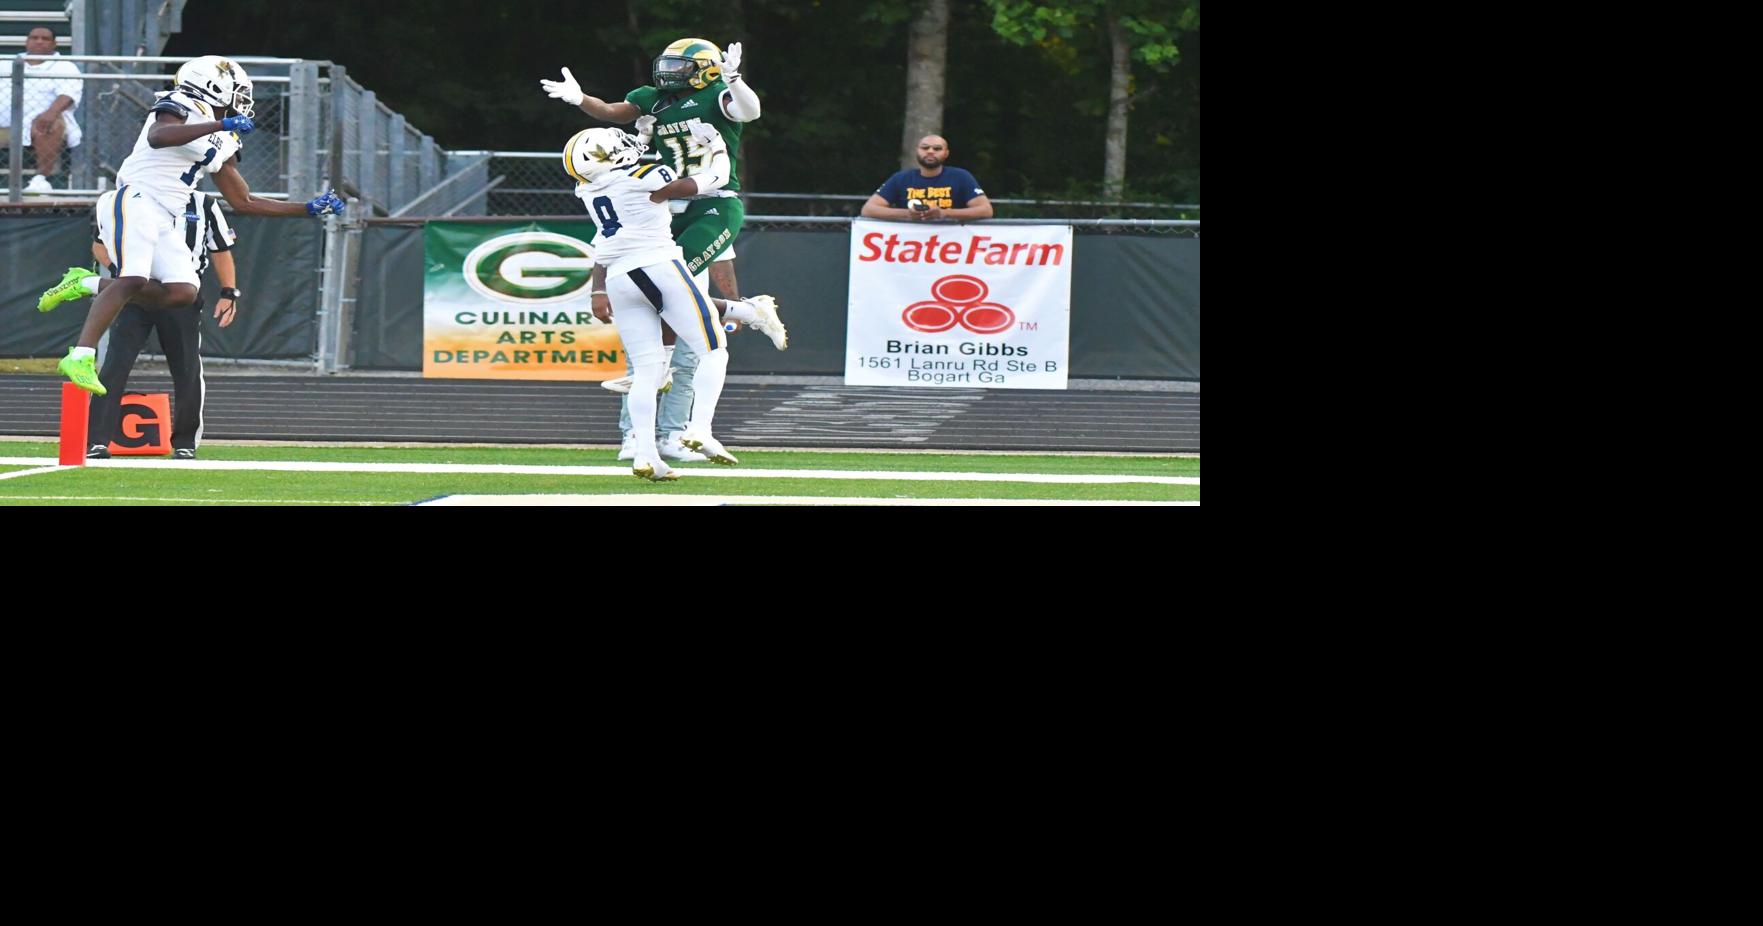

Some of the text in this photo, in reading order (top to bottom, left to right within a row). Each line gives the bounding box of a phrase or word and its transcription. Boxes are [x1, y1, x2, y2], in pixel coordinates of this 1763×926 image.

[658, 168, 672, 183] 8
[687, 228, 732, 272] GRAYSON
[454, 311, 593, 325] CULINAR
[496, 331, 576, 344] ARTS
[886, 340, 1029, 357] Brian Gibbs
[432, 350, 626, 364] DEPARTMEN
[858, 357, 1058, 373] 1561 Lanru Rd Ste B
[907, 370, 1006, 384] Bogart Ga
[111, 403, 162, 448] G
